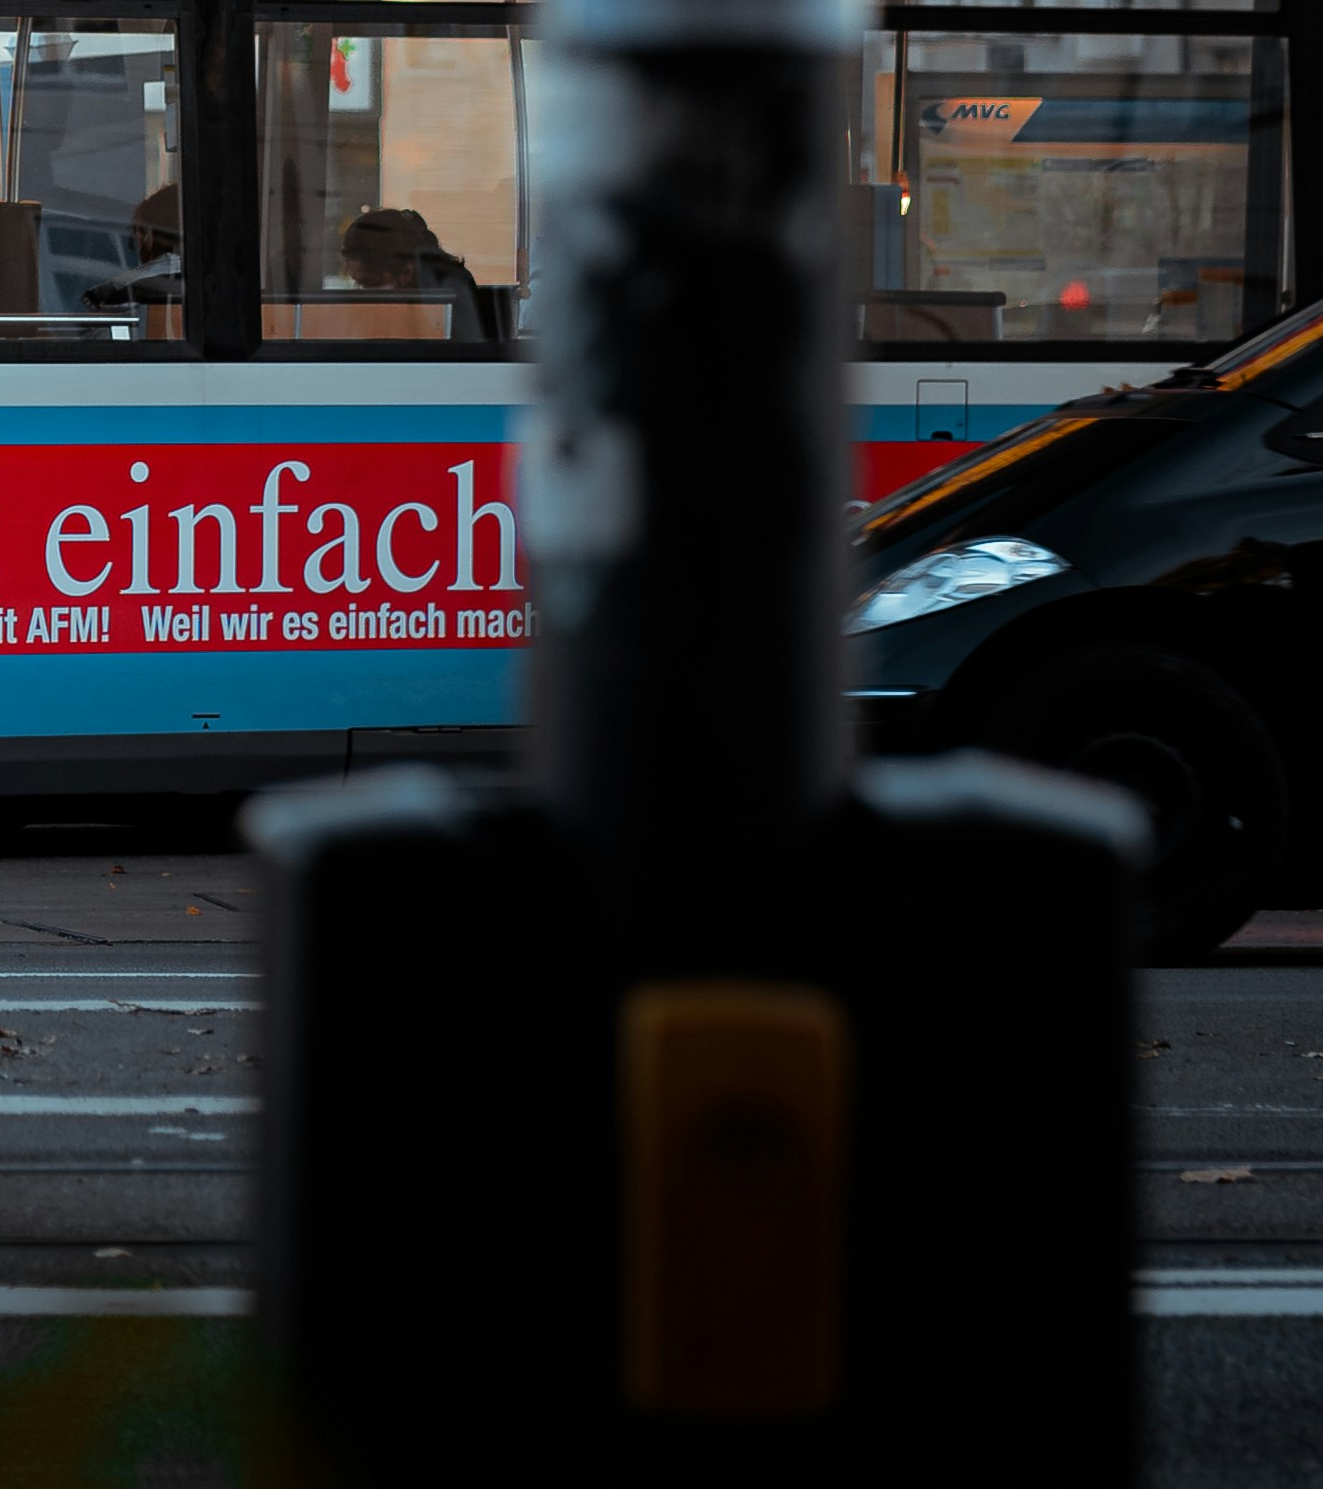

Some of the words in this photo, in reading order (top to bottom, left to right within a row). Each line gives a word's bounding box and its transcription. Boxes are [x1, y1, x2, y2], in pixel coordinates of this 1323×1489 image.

[44, 459, 525, 598] einfach
[24, 605, 111, 646] AFM!
[140, 604, 211, 642] Weil
[220, 603, 274, 641] wir
[282, 610, 321, 640] es
[327, 602, 446, 640] einfach
